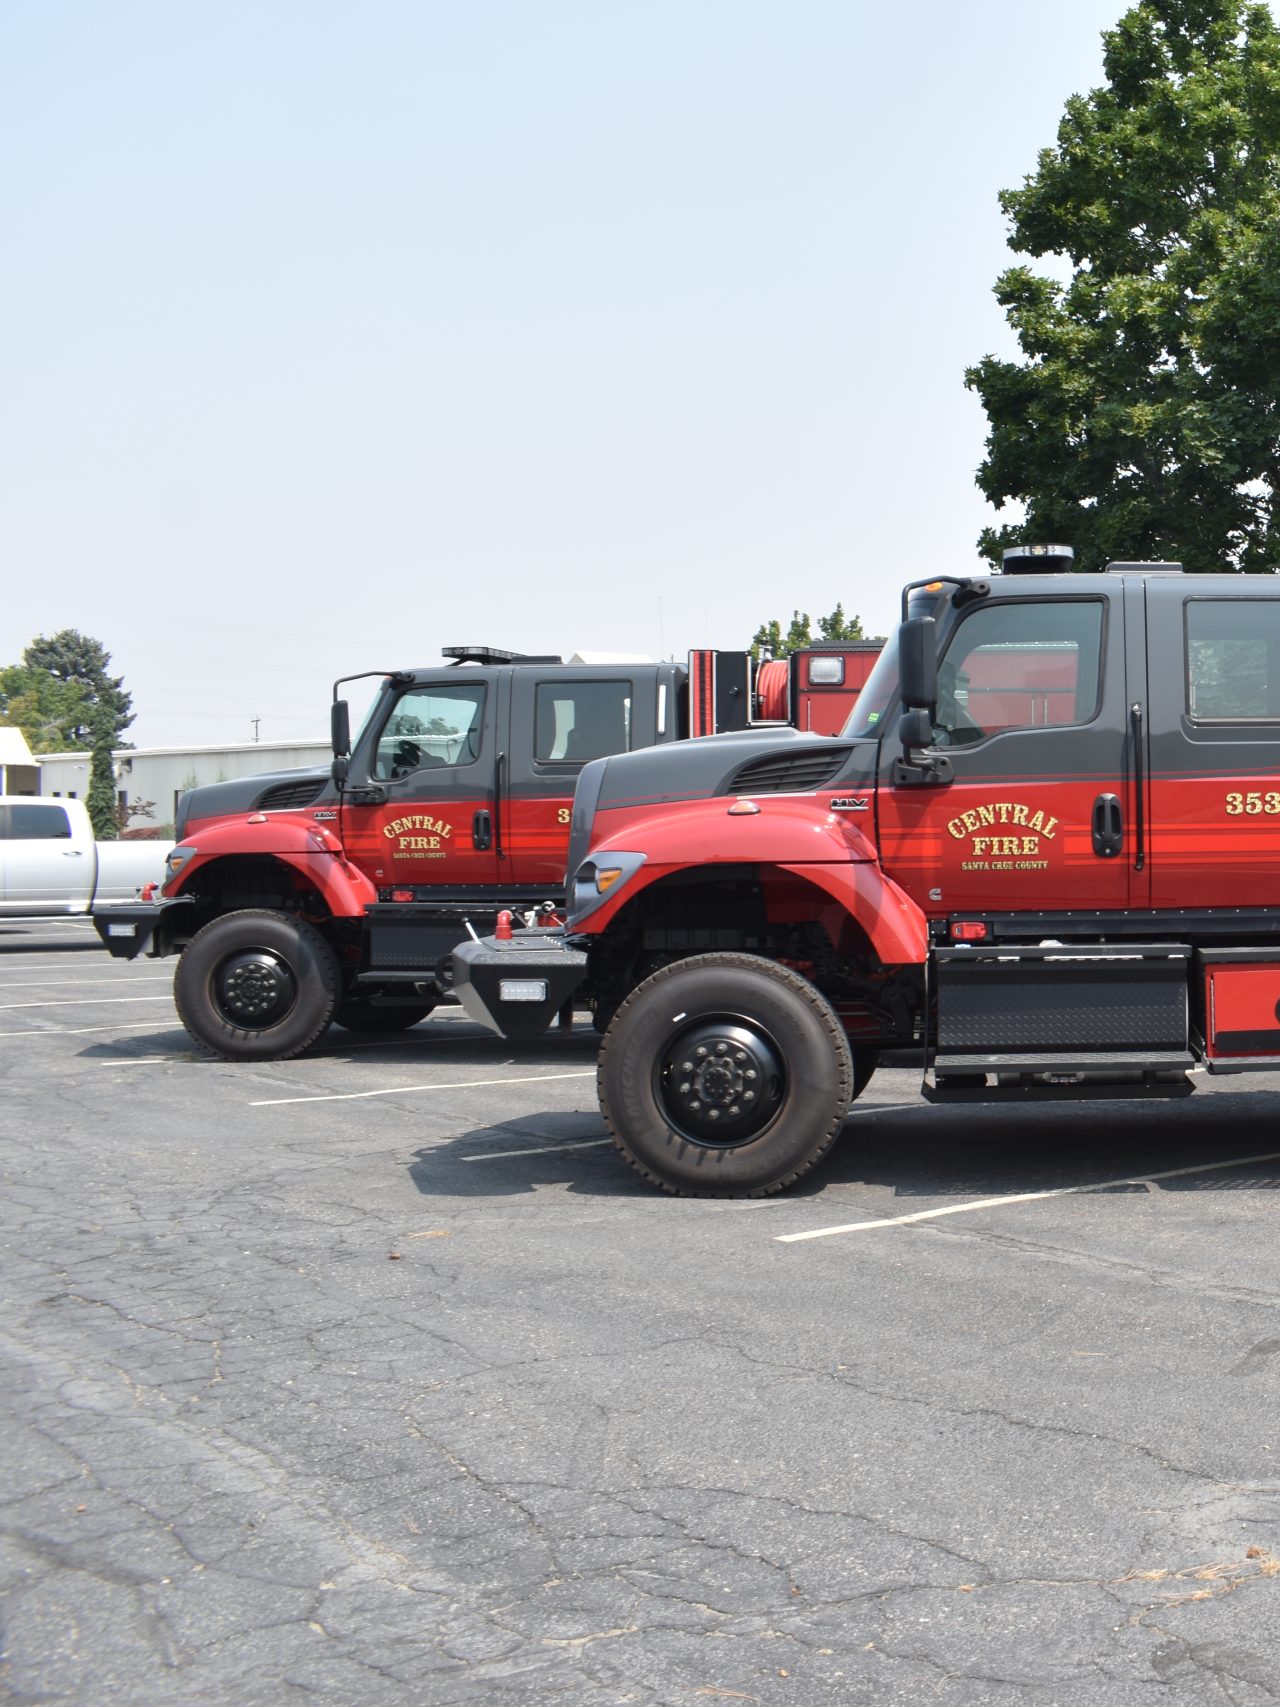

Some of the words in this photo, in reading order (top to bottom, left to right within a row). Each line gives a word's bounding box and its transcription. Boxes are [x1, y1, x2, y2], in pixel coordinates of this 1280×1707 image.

[830, 798, 869, 810] HV
[383, 815, 453, 839] CENTRAL
[947, 803, 1059, 840] CENTRAL
[399, 836, 440, 849] FIRE
[971, 837, 1039, 856] FIRE
[961, 861, 990, 871] SANTA
[991, 861, 1013, 870] CRUZ
[1015, 860, 1049, 870] COUNTY
